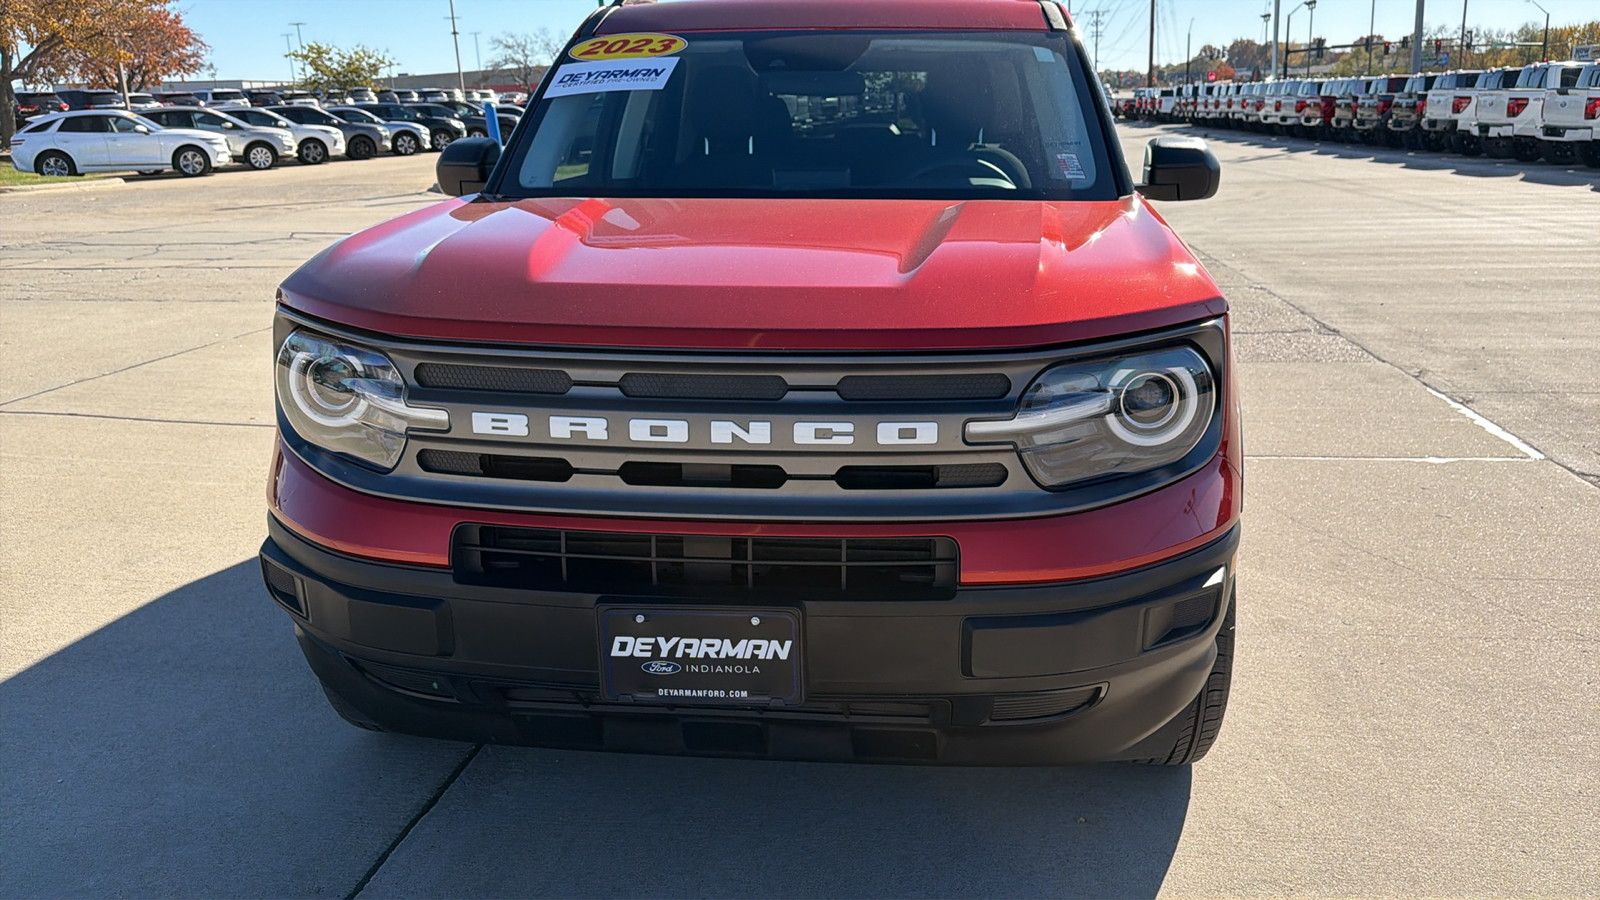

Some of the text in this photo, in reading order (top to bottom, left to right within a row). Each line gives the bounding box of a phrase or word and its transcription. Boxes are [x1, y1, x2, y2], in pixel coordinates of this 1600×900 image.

[578, 38, 678, 57] 2023
[557, 68, 666, 84] DEYARMAN
[562, 79, 605, 88] CERTIFIED
[472, 411, 939, 445] BRONCO
[610, 636, 793, 660] DEYARMAN
[648, 661, 761, 674] Ford INDIANOLA
[658, 688, 748, 698] DEYARMANFORD.COM
